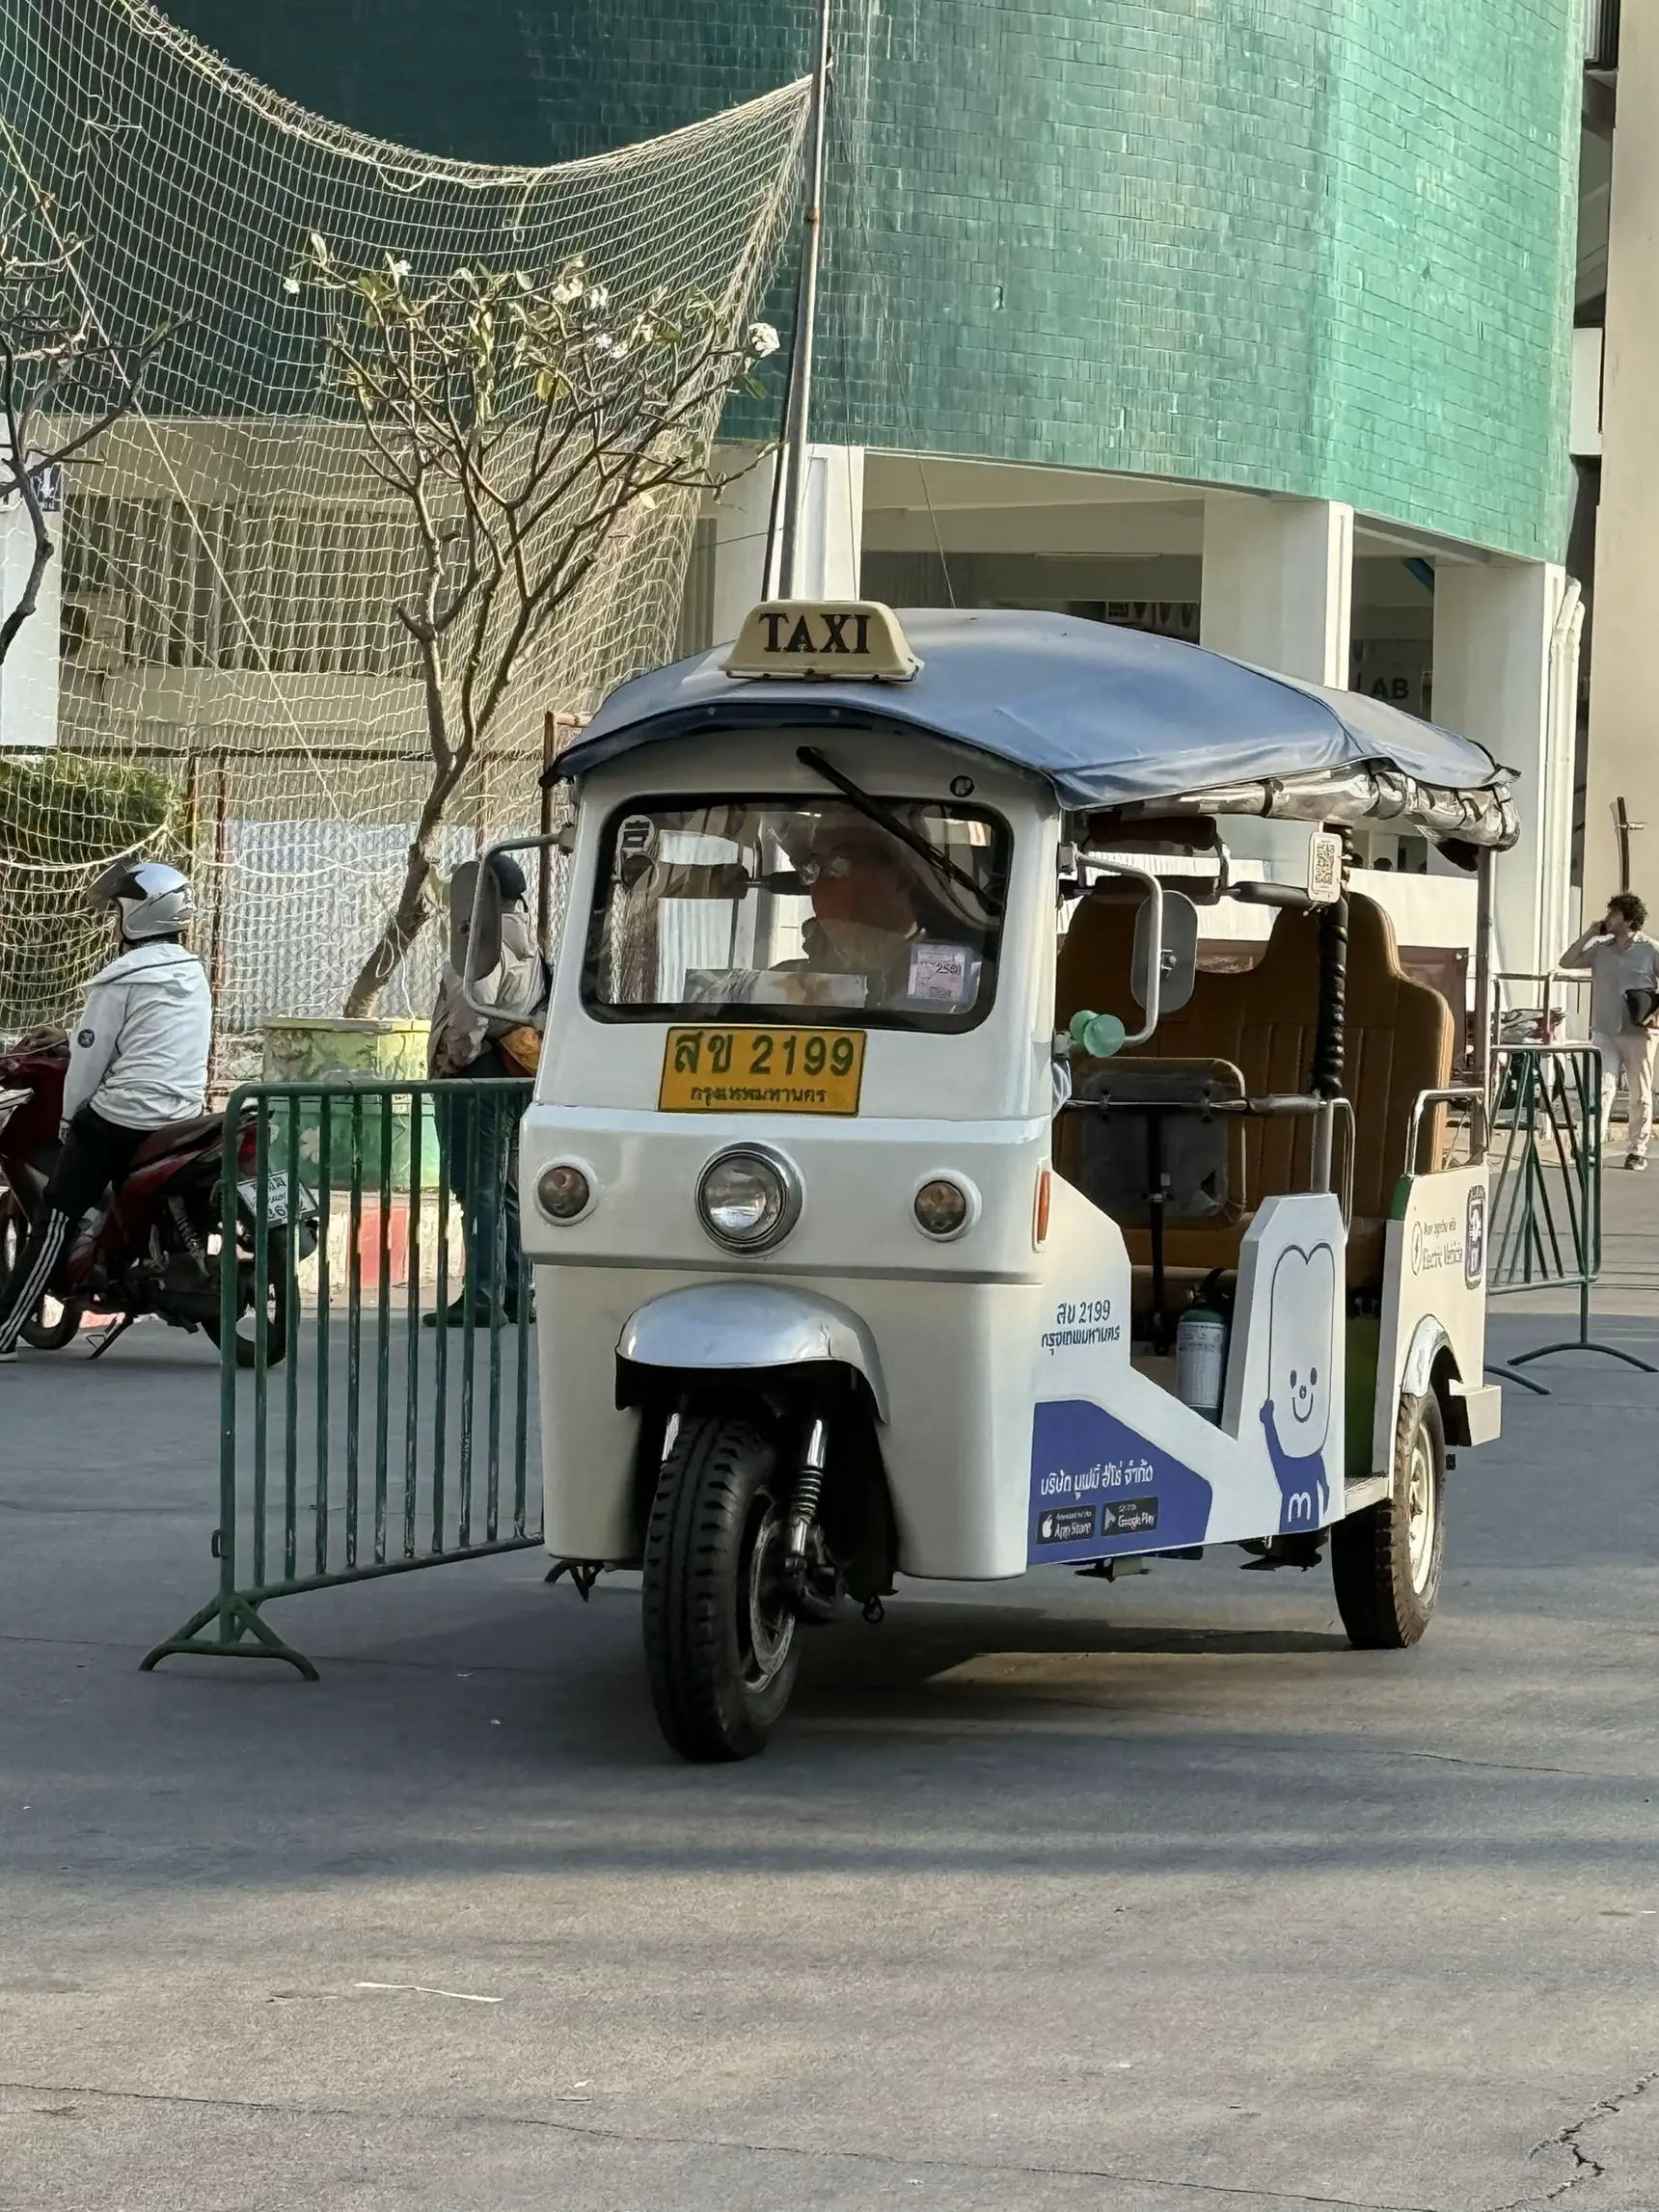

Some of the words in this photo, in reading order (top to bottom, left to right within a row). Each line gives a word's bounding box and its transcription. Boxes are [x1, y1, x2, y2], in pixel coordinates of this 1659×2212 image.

[758, 612, 872, 654] TAXI
[674, 1030, 734, 1074] สข
[748, 1034, 856, 1077] 2199
[690, 1086, 828, 1107] กรุงเทพมหานคร
[1078, 1299, 1111, 1324] 2199
